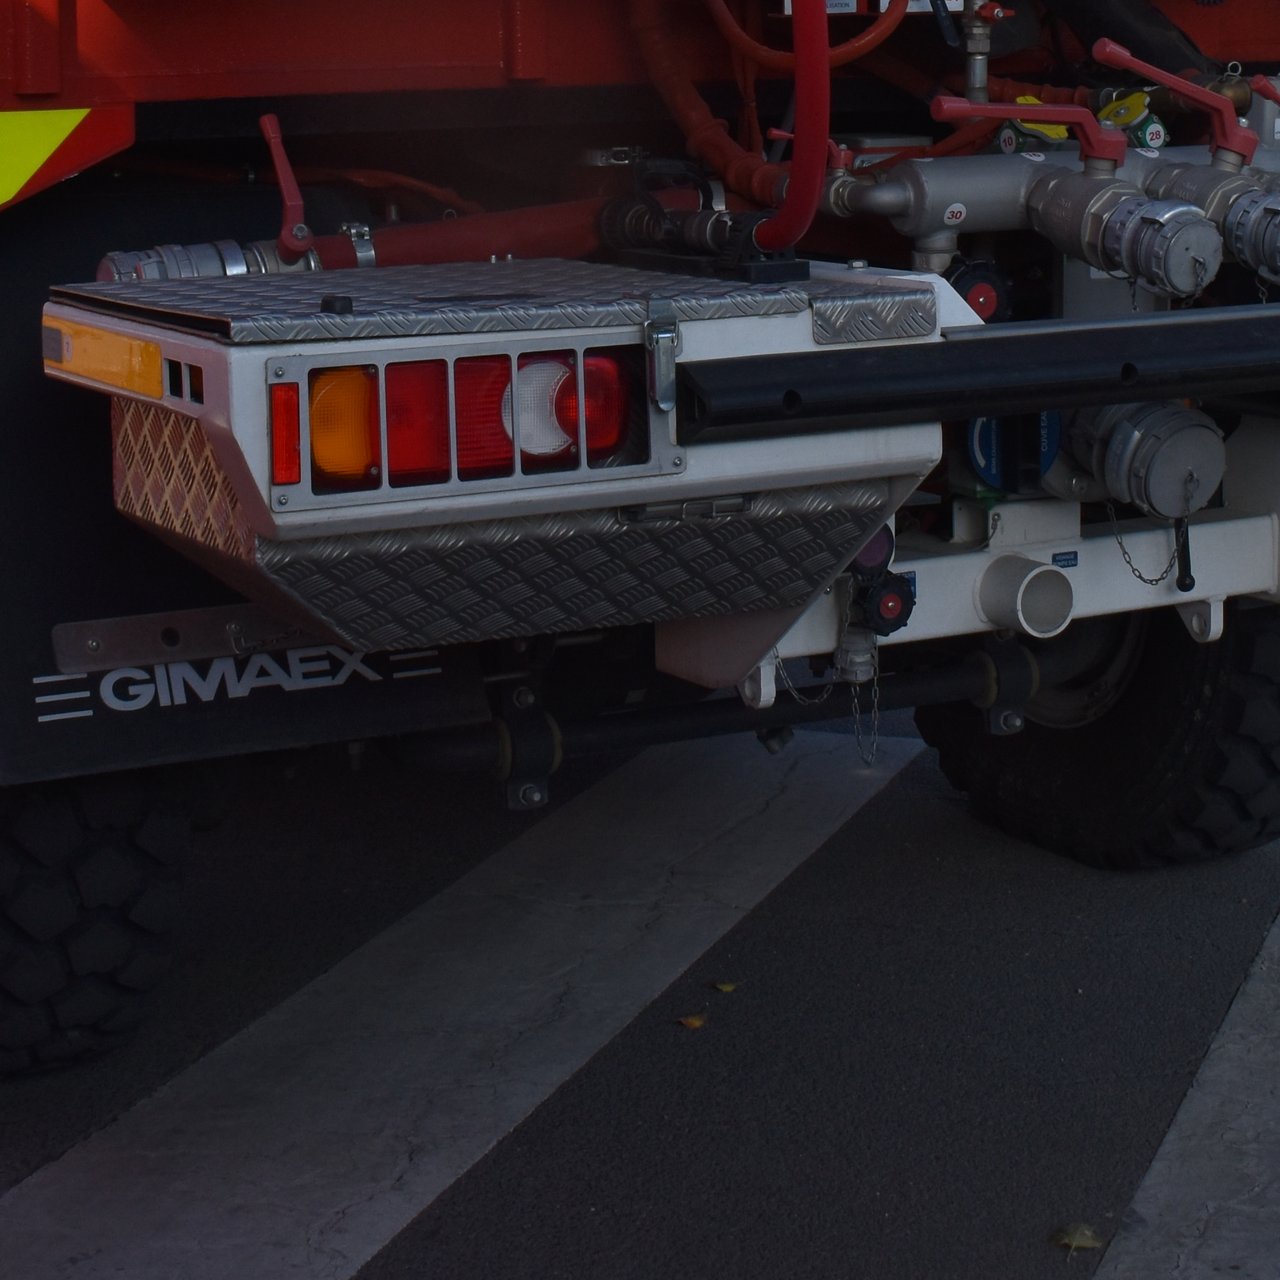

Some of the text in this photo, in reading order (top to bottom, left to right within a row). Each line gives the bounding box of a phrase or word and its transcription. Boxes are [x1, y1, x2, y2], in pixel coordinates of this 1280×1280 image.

[1149, 130, 1162, 141] 28
[1002, 136, 1014, 148] 10
[947, 210, 963, 220] 30
[1040, 428, 1048, 452] CUVE
[99, 644, 383, 712] GIMAEX
